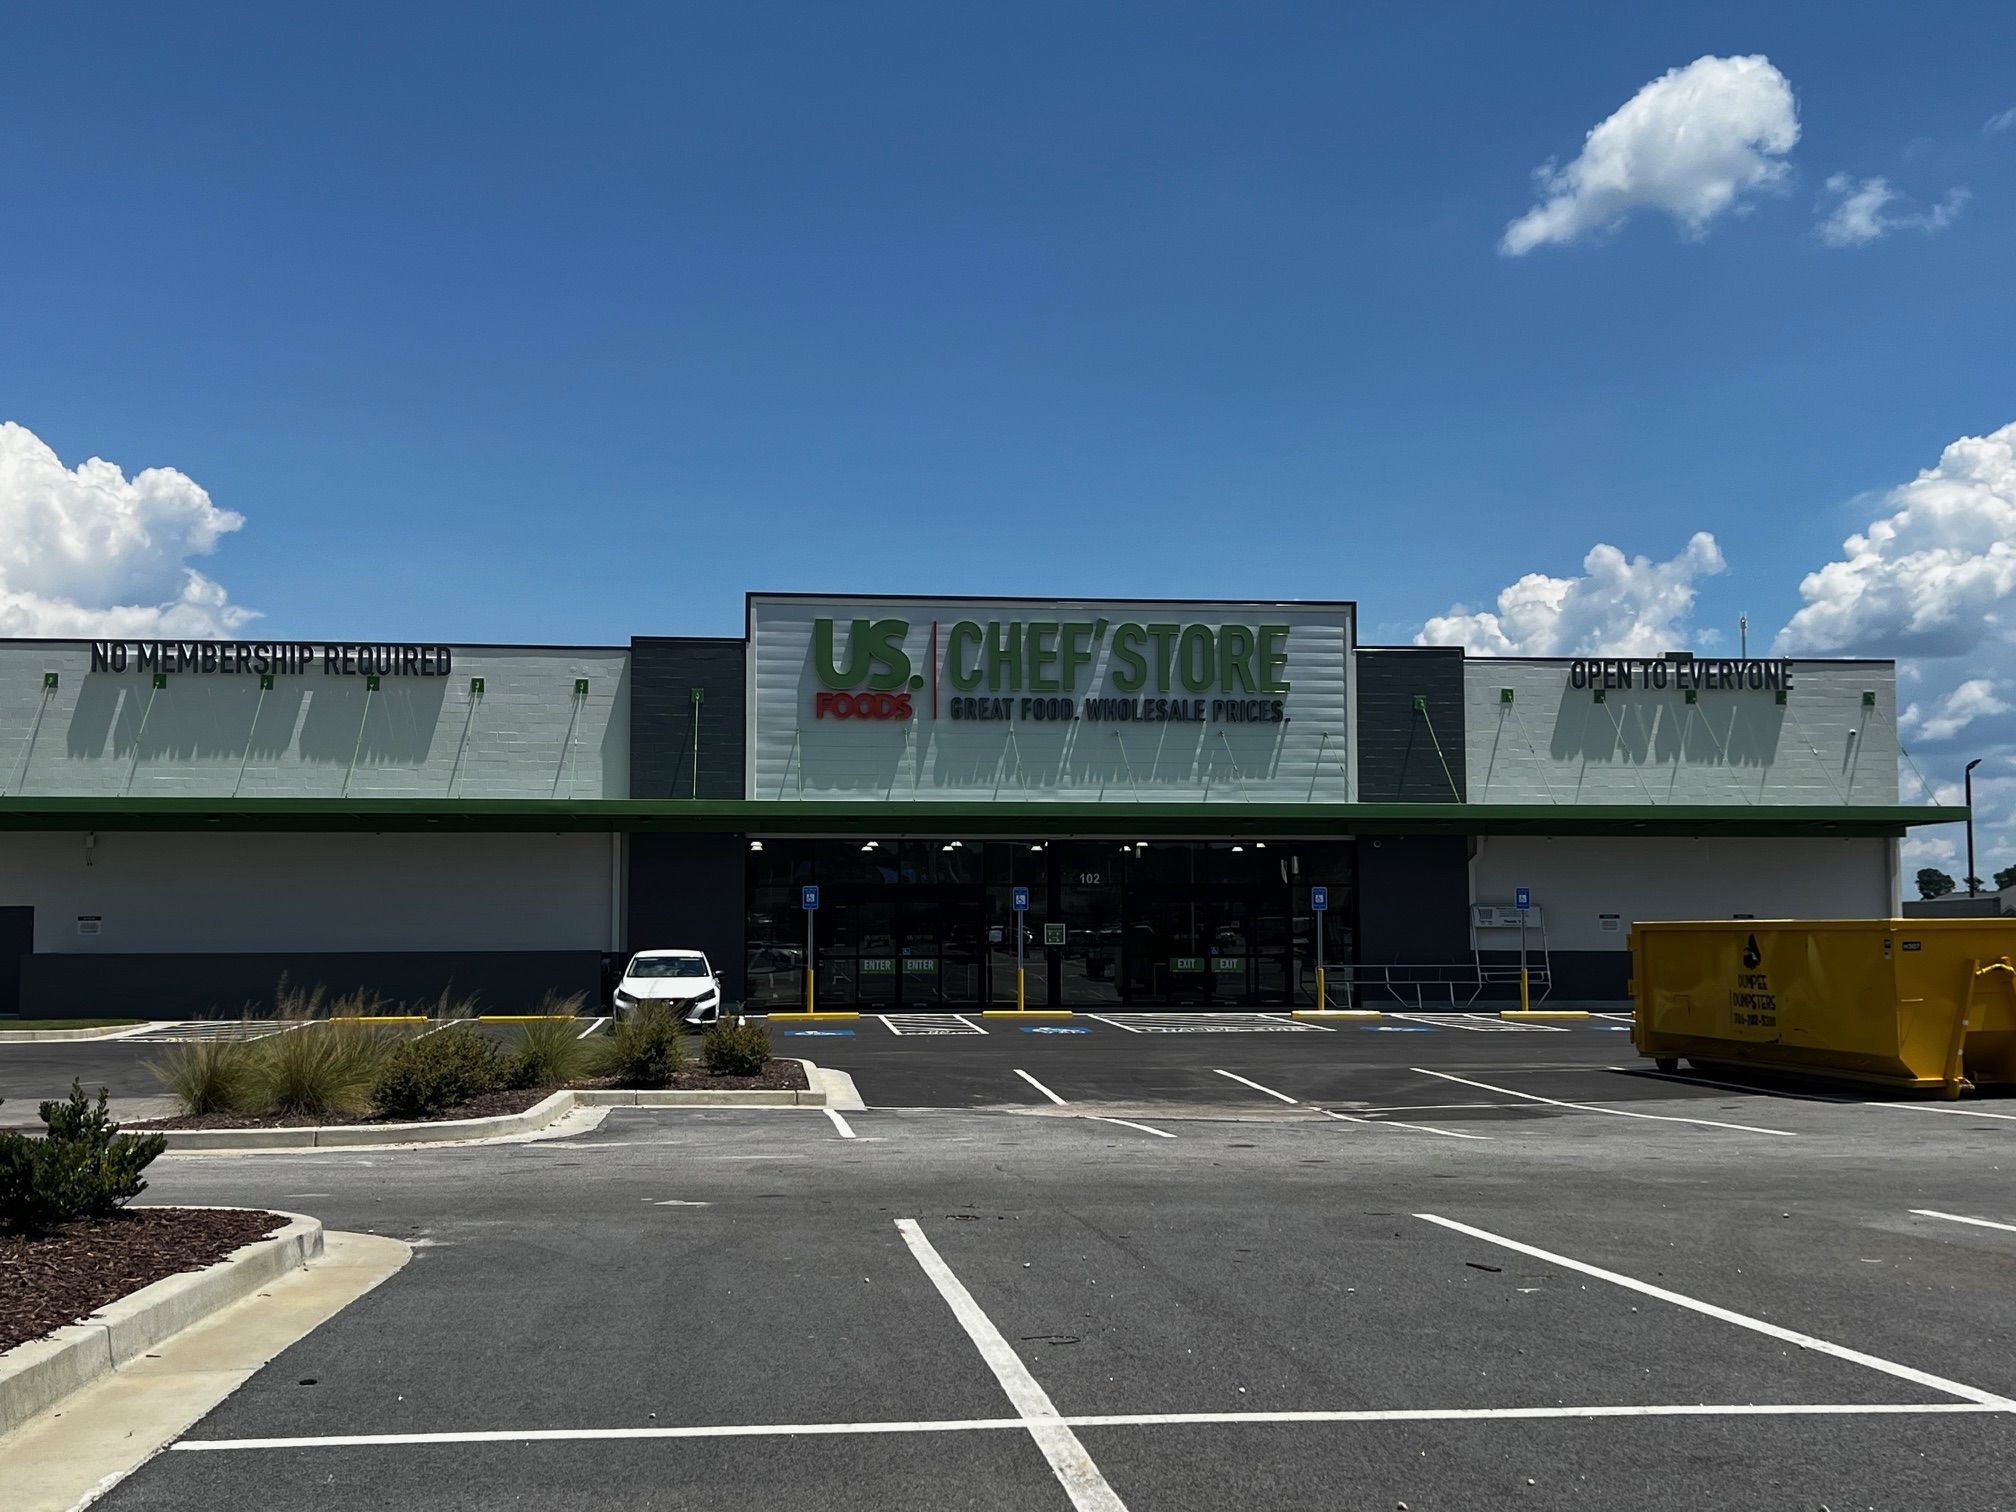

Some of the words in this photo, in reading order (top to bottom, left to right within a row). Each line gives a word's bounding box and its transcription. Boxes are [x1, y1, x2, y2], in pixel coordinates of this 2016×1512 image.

[91, 641, 129, 673] NO
[137, 642, 314, 675] MEMBERSHIP
[324, 644, 453, 677] REQUIRED
[815, 618, 924, 691] US.
[950, 617, 1291, 693] CHEF'STORE
[1570, 660, 1632, 690] OPEN
[1639, 660, 1668, 690] TO
[1676, 660, 1795, 691] EVERYONE
[816, 692, 913, 721] FOODS
[950, 696, 1014, 721] GREAT
[1086, 697, 1206, 723] WHOLESALE
[1212, 698, 1292, 724] PRICES.
[1079, 872, 1101, 885] 102
[864, 959, 891, 971] ENTER
[907, 959, 934, 971] ENTER
[1177, 958, 1196, 969] EXIT
[1219, 958, 1238, 969] EXIT
